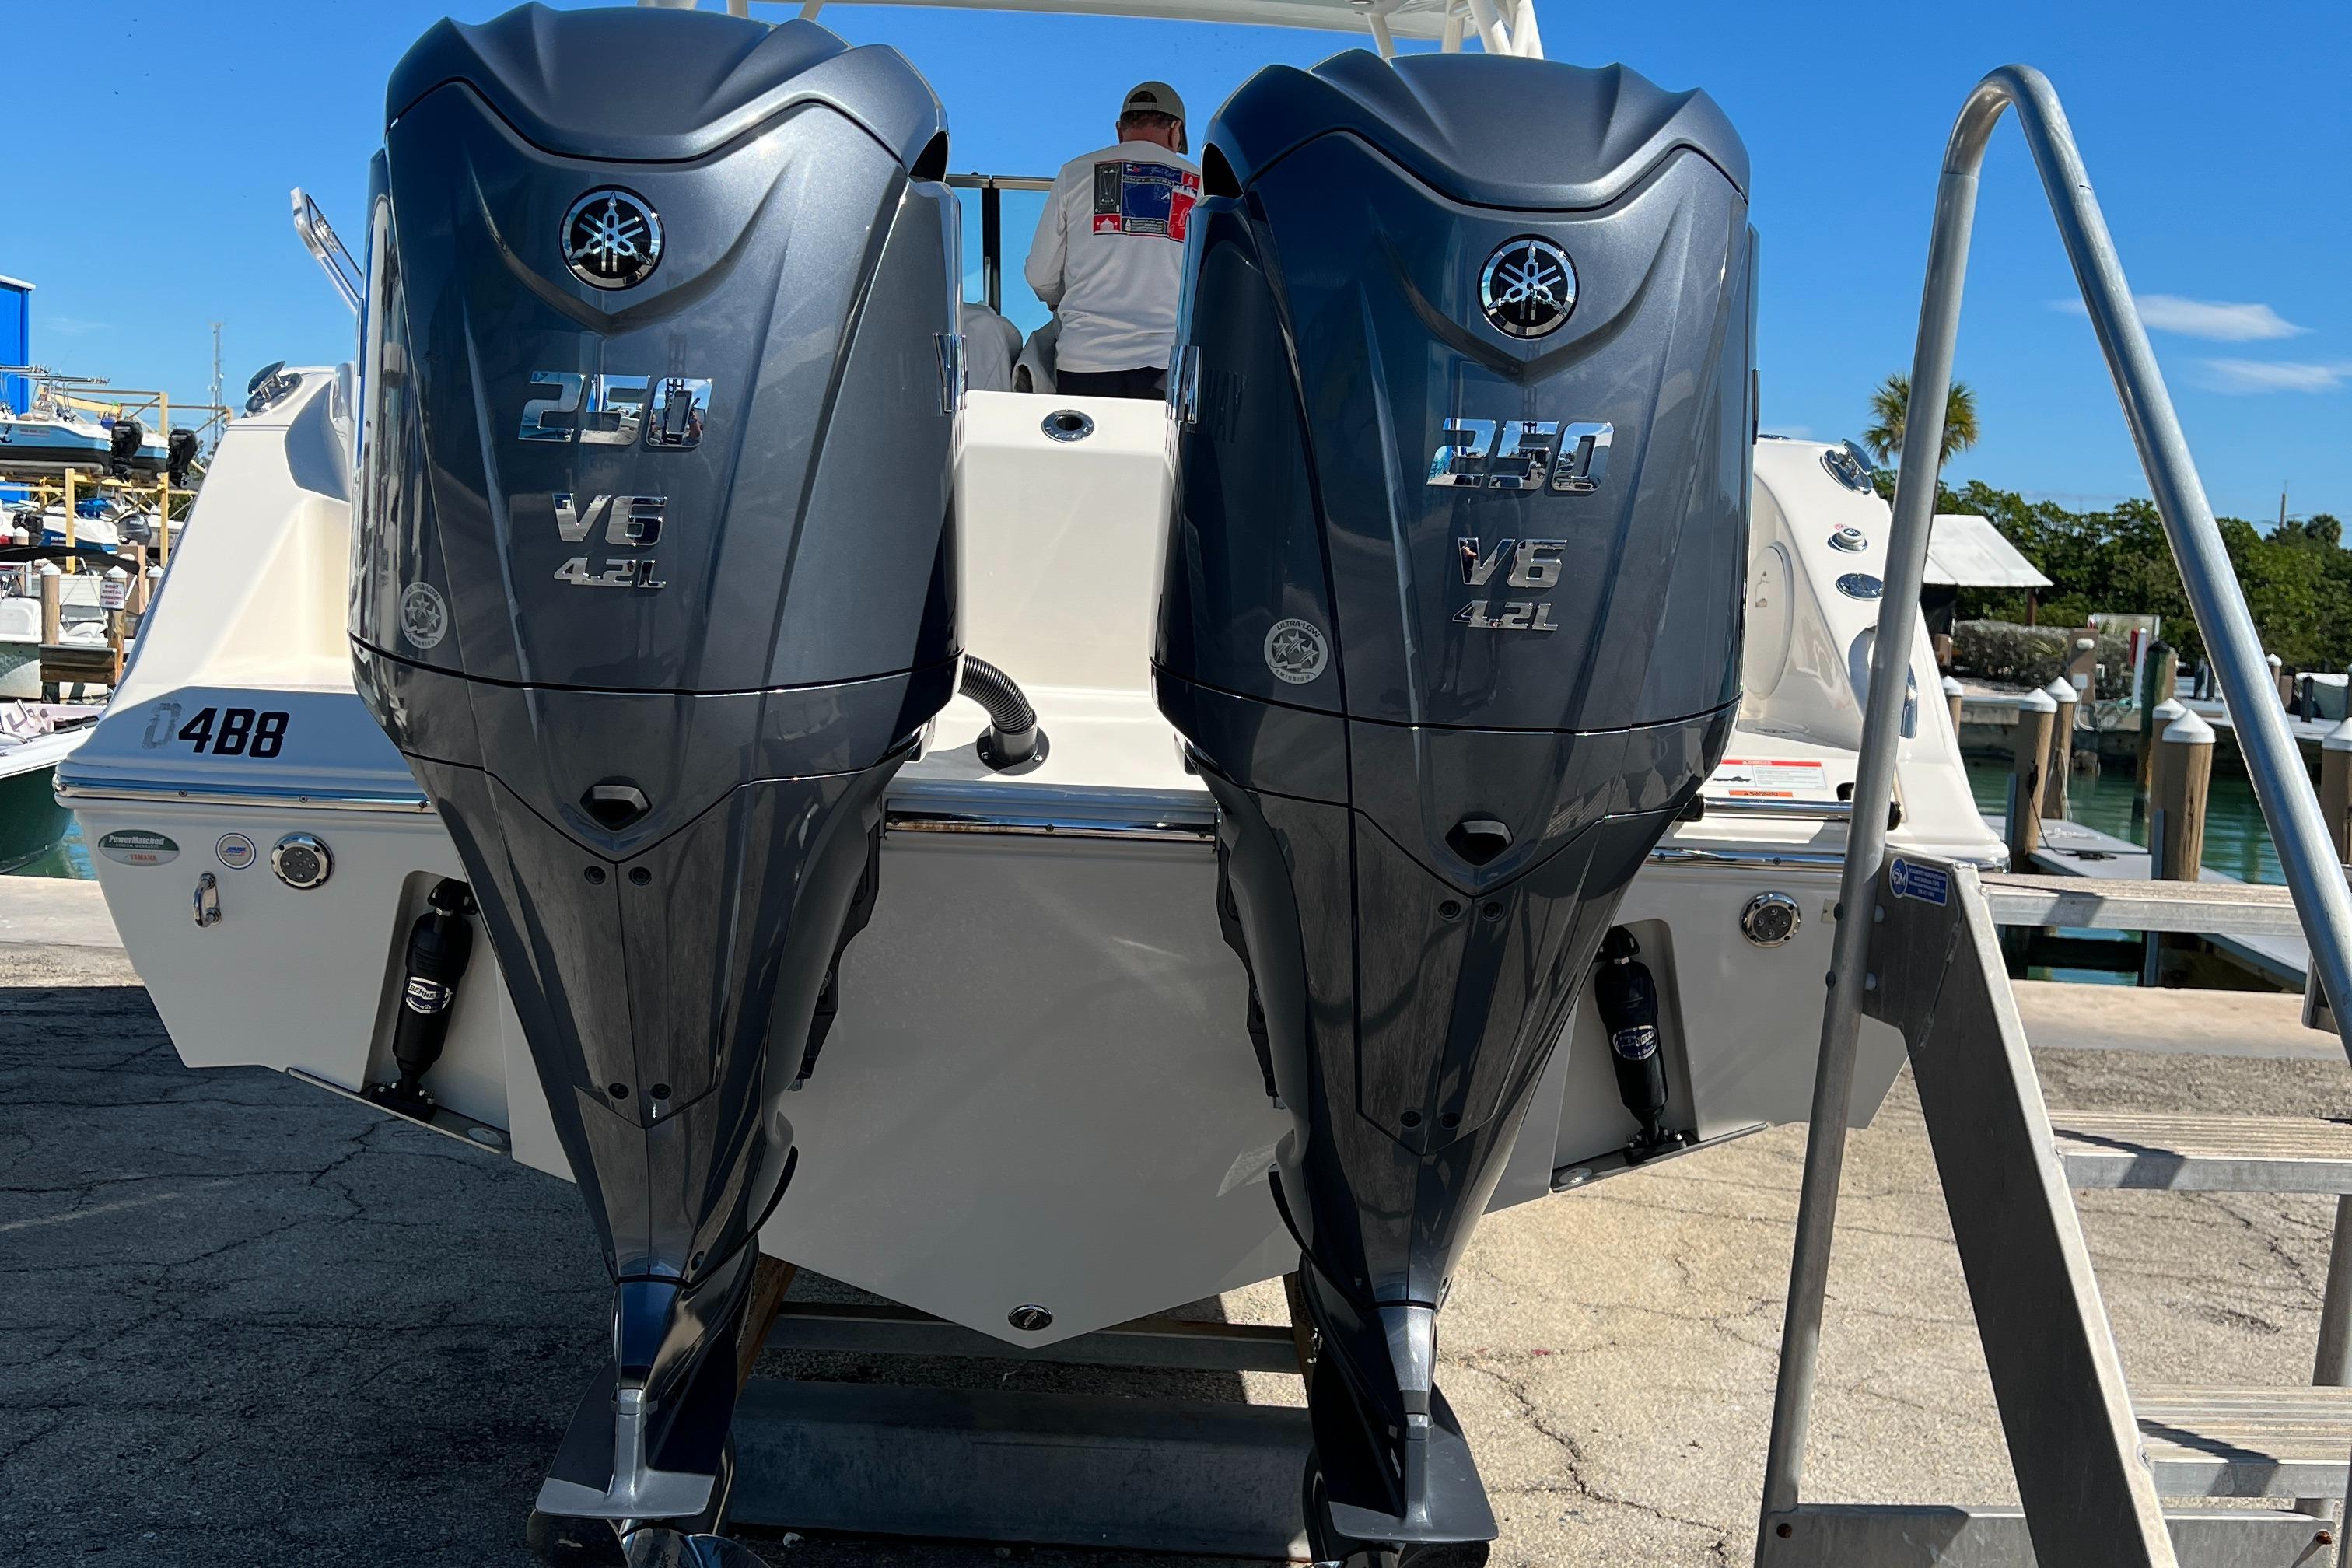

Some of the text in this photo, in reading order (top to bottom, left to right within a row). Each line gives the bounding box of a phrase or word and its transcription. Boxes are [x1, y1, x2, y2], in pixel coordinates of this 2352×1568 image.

[518, 371, 712, 448] 250
[1426, 418, 1614, 491] 250
[552, 493, 667, 546] V6
[1458, 537, 1568, 588] V6
[109, 835, 166, 845] PowerMatched
